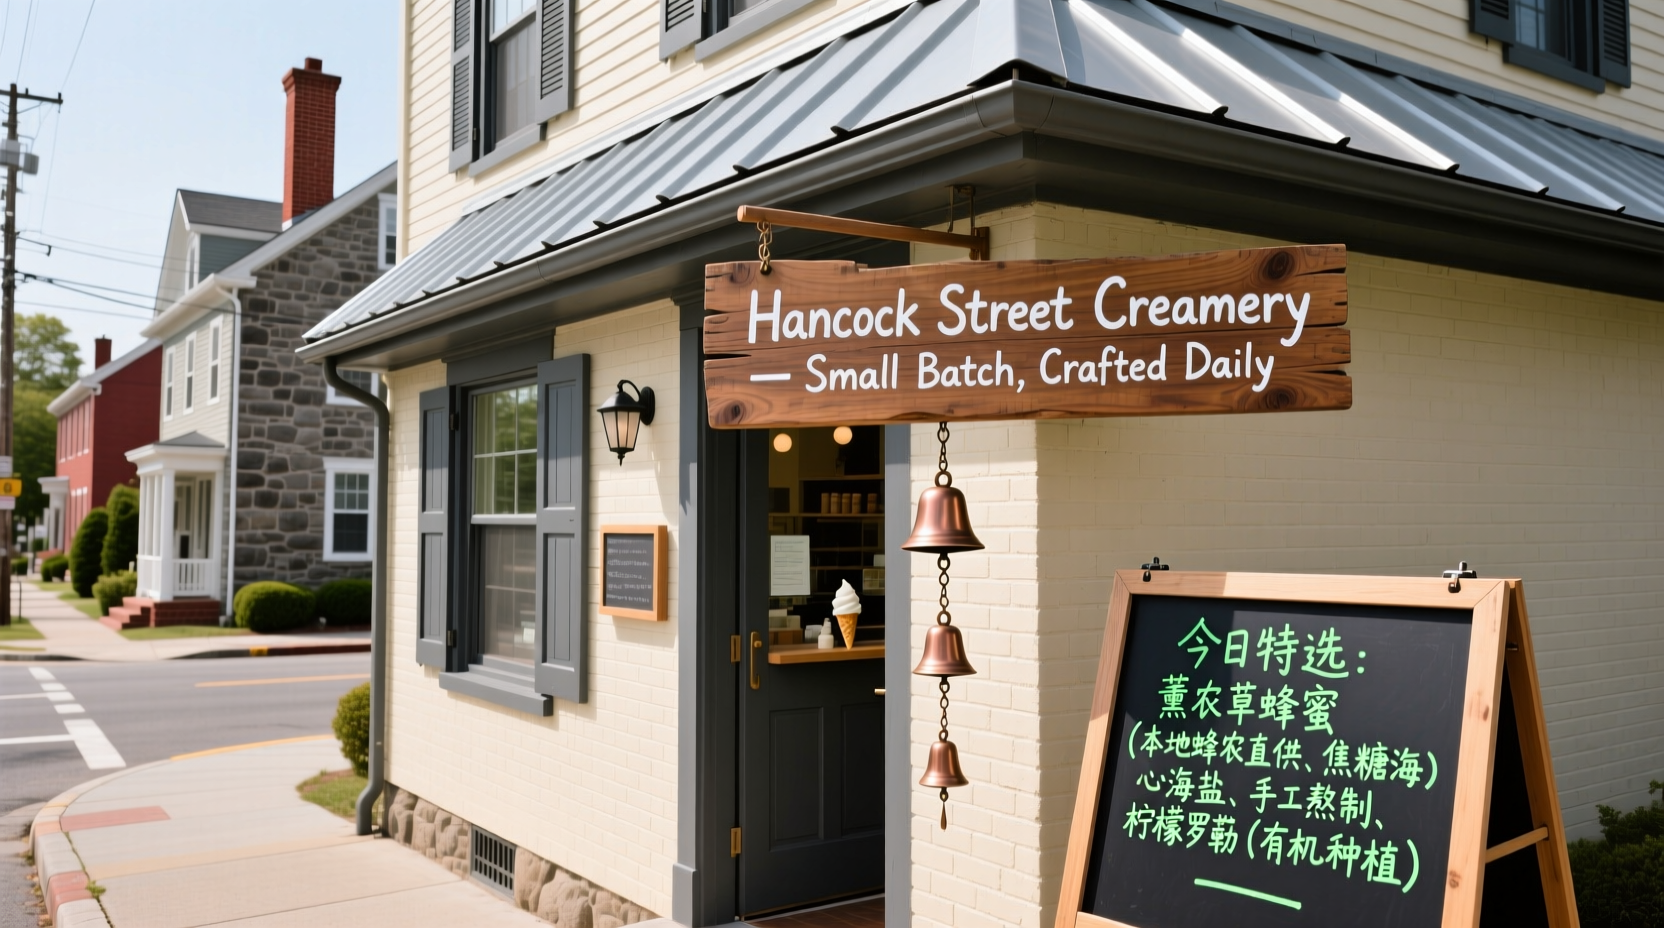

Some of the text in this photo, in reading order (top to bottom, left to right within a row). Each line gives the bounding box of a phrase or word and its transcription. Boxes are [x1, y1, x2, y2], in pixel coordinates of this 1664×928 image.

[747, 274, 1311, 347] Hancock Street Creamery
[805, 352, 899, 394] Small
[917, 350, 1026, 393] Batch,
[1039, 345, 1167, 386] Crafted
[1185, 340, 1275, 393] Daily
[1177, 616, 1367, 679] 今日特选：
